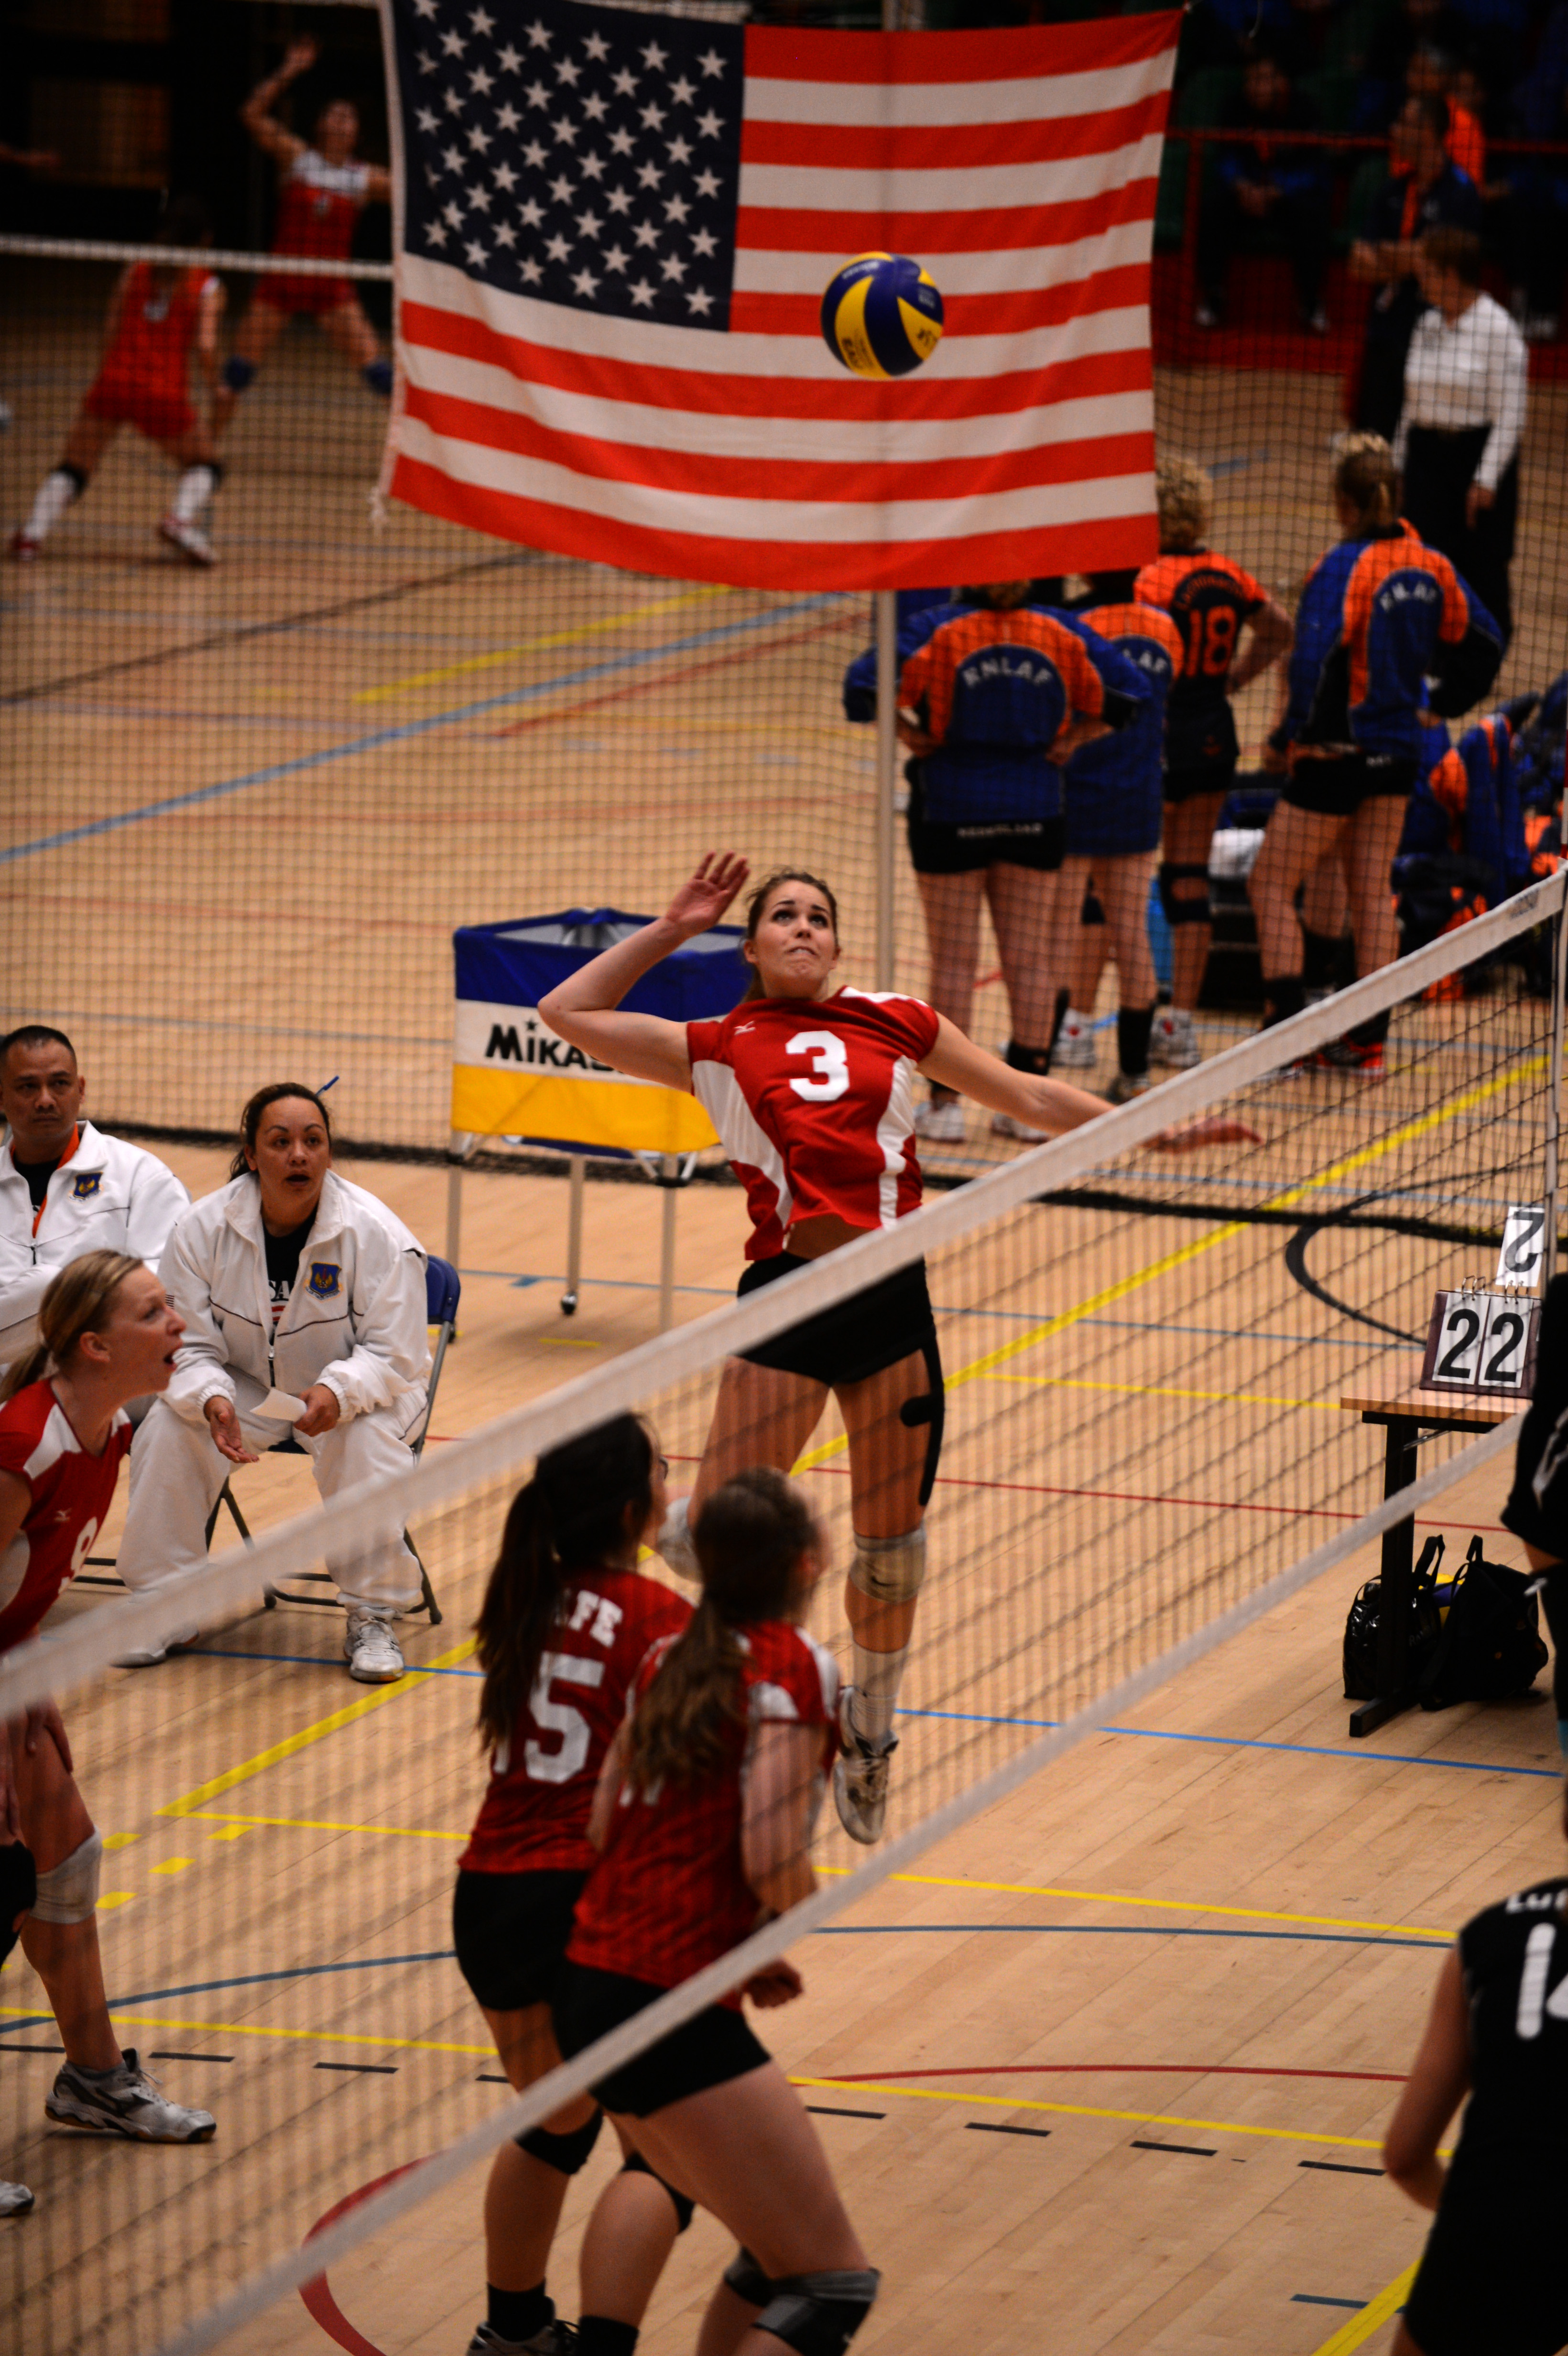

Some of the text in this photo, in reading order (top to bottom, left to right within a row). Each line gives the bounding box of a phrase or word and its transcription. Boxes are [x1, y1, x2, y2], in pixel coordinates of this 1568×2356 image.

[1185, 605, 1237, 678] 18
[785, 1030, 849, 1101] 3
[1437, 1309, 1524, 1383] 22
[493, 1650, 605, 1784] 5
